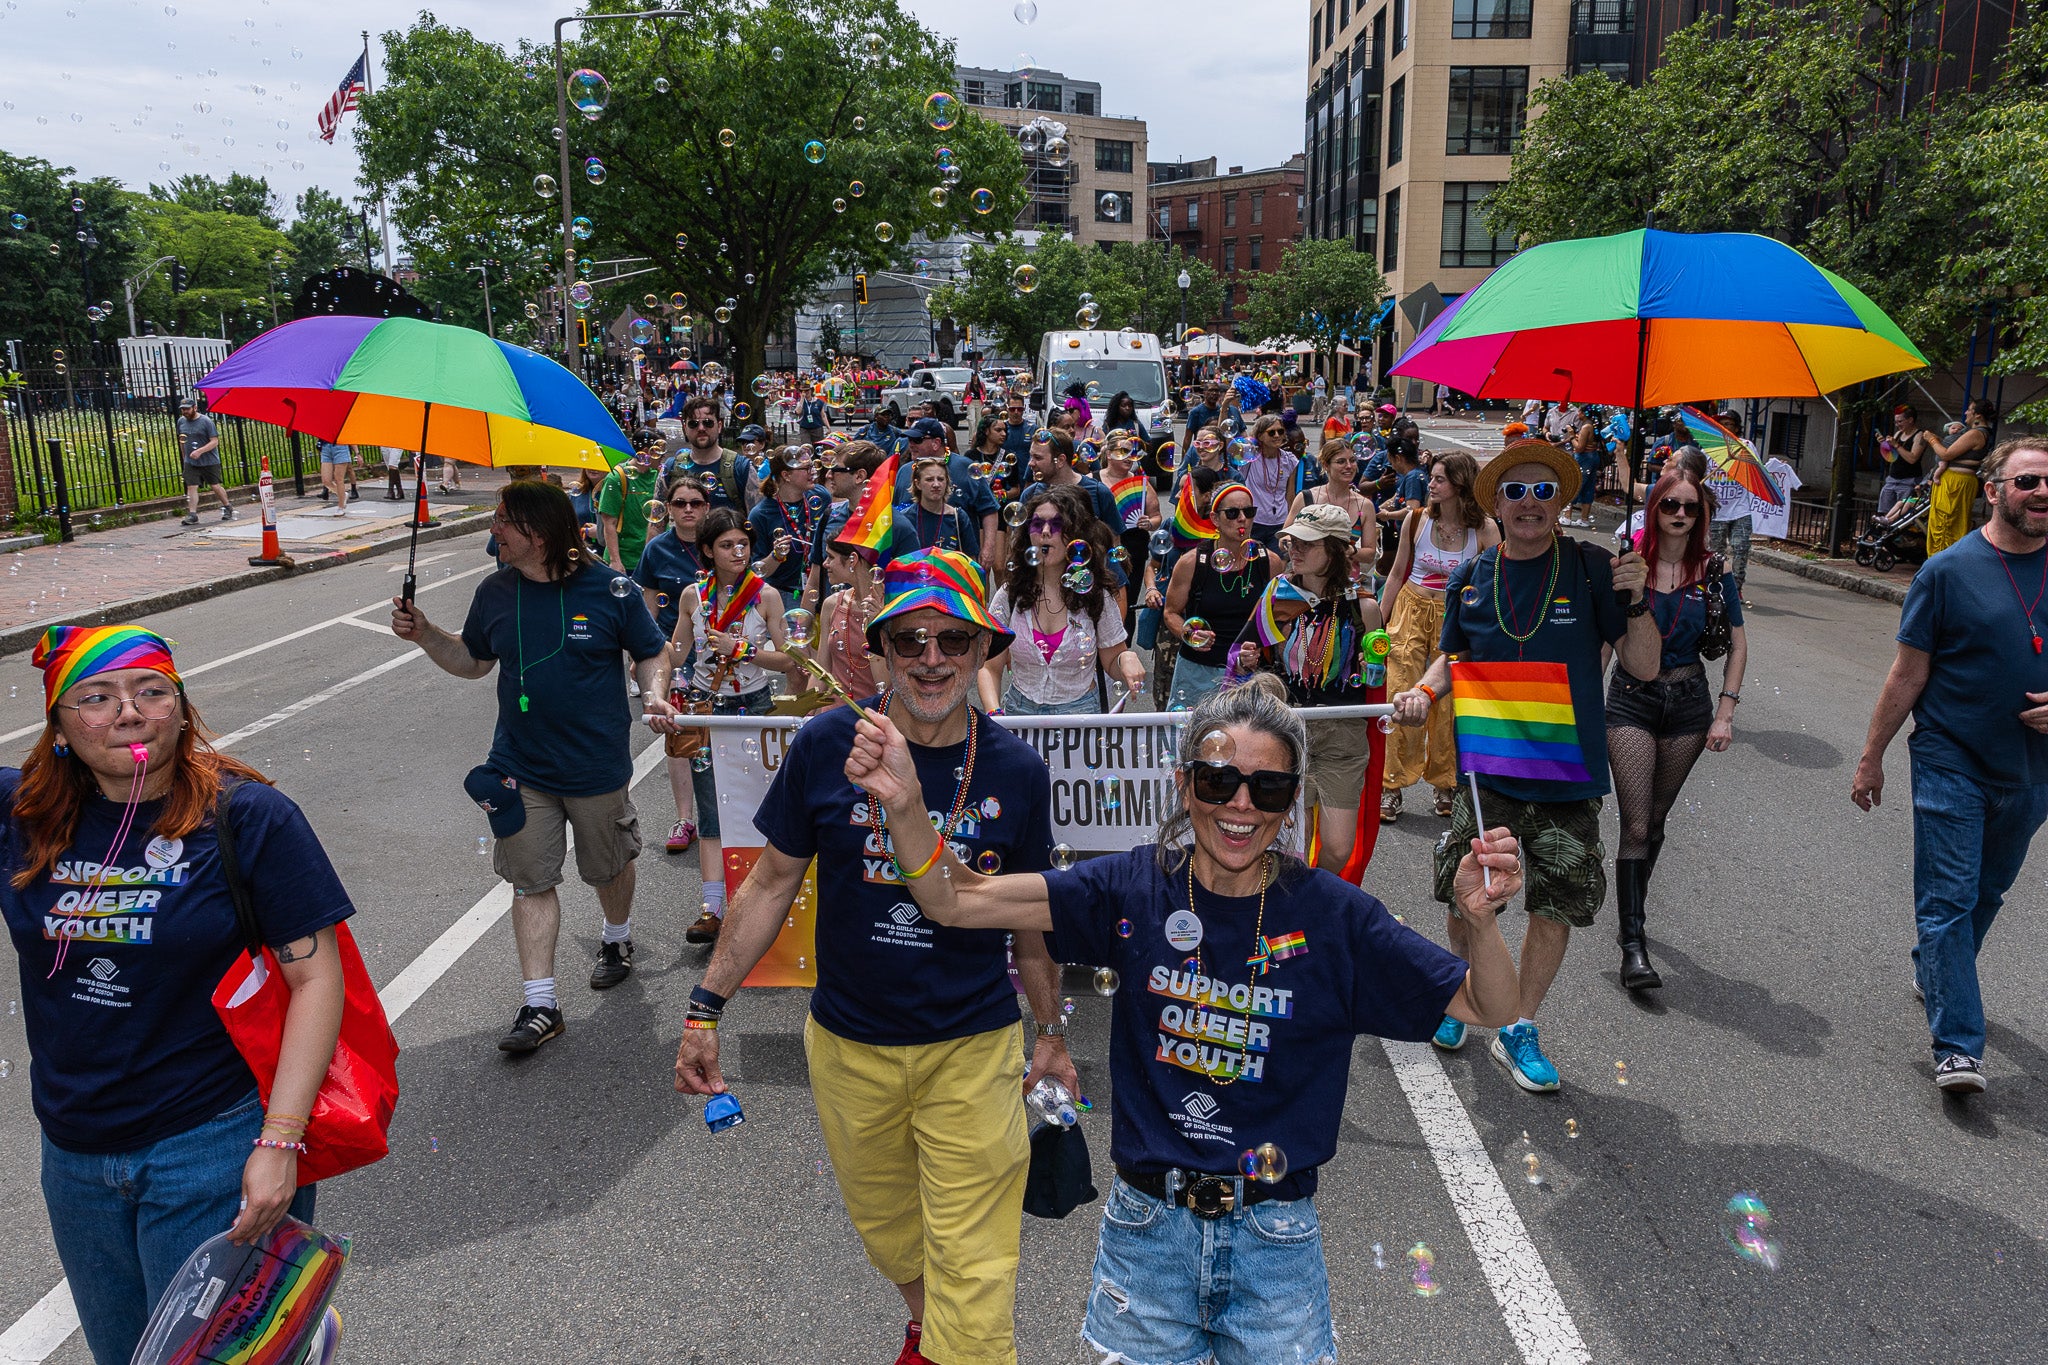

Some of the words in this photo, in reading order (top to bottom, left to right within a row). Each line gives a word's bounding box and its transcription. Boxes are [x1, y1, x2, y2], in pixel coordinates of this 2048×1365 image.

[1052, 779, 1174, 826] COMMU
[52, 861, 190, 882] SUPPORT
[56, 890, 162, 913] QUEER
[44, 916, 152, 939] YOUTH
[895, 931, 917, 939] BOSTON
[904, 940, 933, 949] EVERYONE
[94, 989, 114, 997] BOSTON
[111, 984, 130, 993] CLUBS
[1149, 965, 1293, 1015] SUPPORT
[76, 993, 90, 1001] CLUB
[101, 998, 132, 1008] EVERYONE
[1161, 1005, 1271, 1048] QUEER
[1158, 1033, 1265, 1079] YOUTH
[1190, 1132, 1203, 1140] FOR
[1211, 1123, 1233, 1133] CLUBS
[211, 1317, 233, 1345] This
[228, 1302, 241, 1313] Is
[239, 1289, 248, 1300] A
[245, 1262, 263, 1286] Set
[231, 1314, 249, 1337] DO
[246, 1281, 266, 1312] NOT
[239, 1279, 287, 1351] SEPARATE
